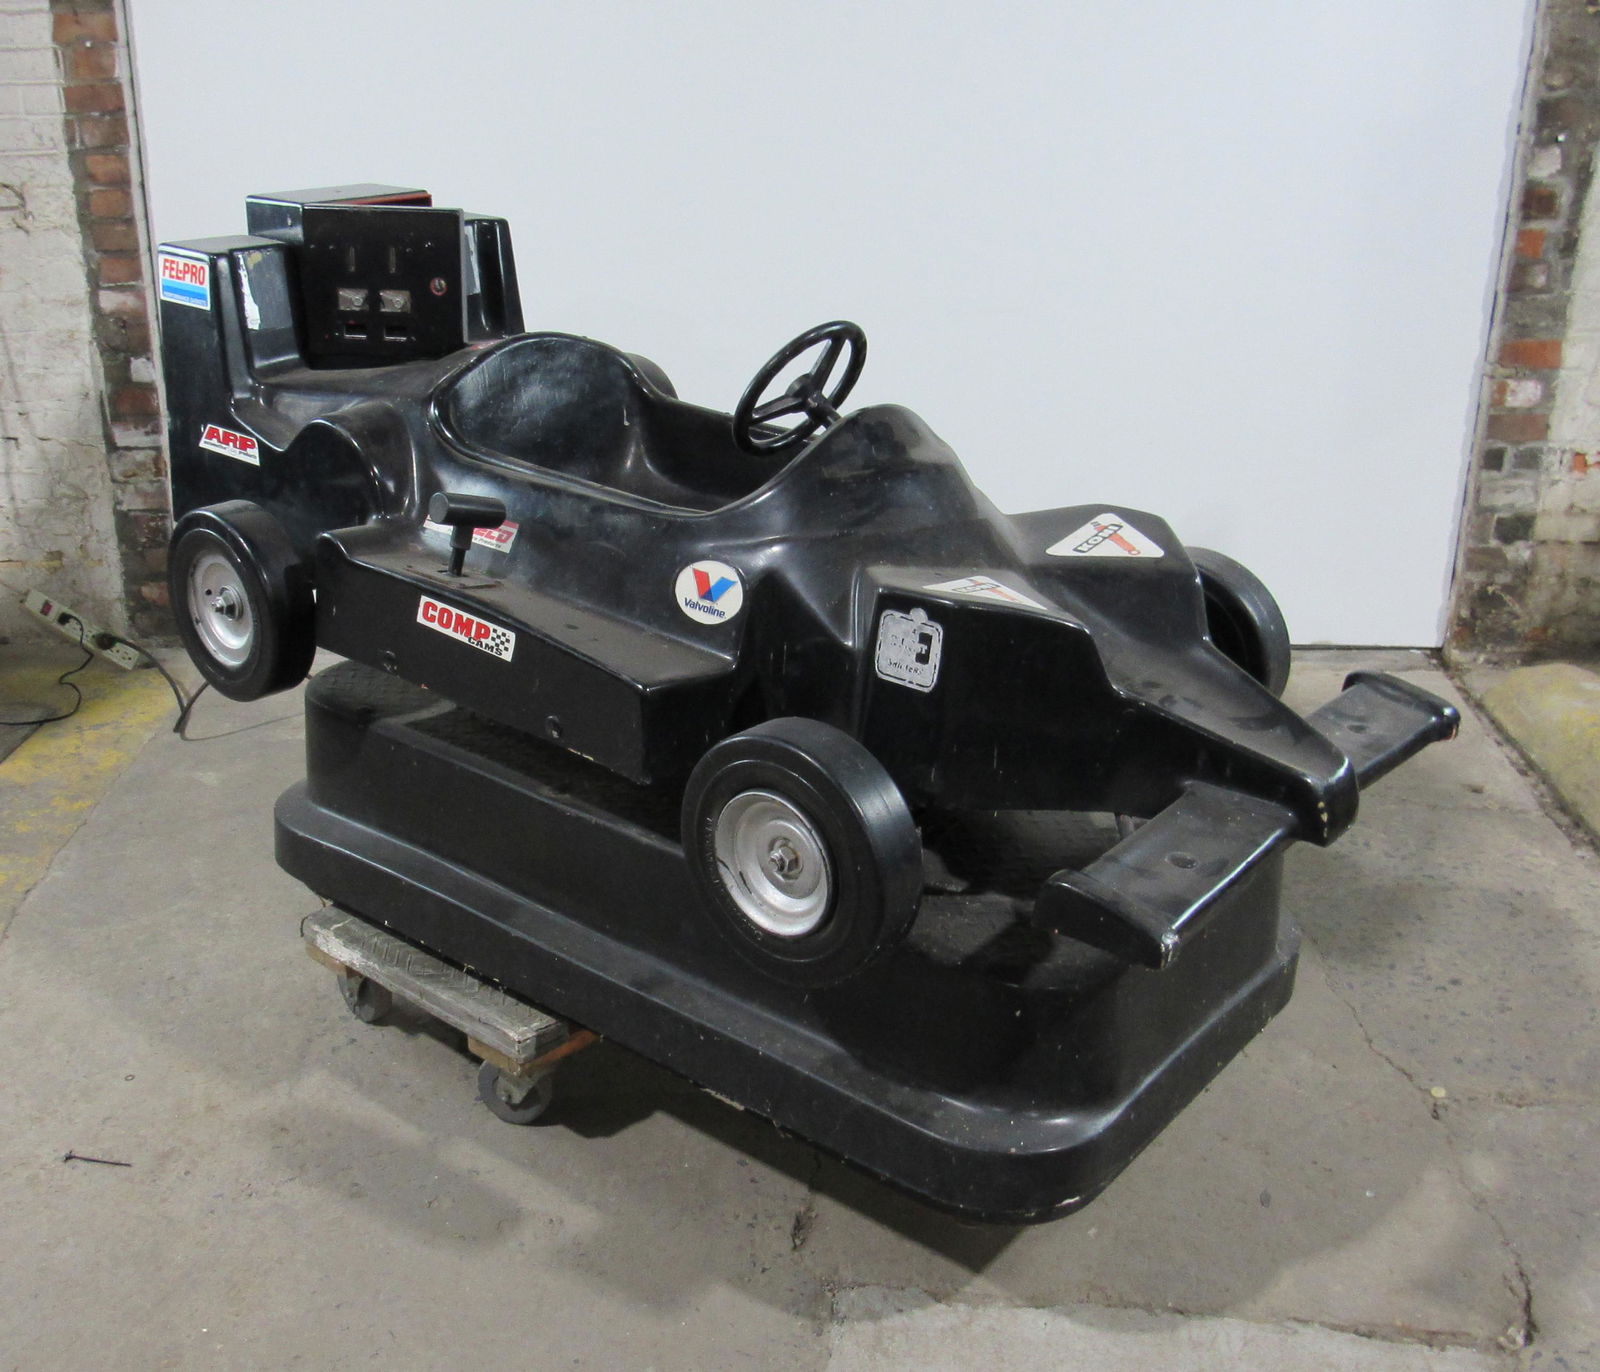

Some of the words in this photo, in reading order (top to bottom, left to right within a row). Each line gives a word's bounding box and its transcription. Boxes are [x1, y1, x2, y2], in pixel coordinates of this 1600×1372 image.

[162, 258, 206, 286] FEL-PRO
[204, 426, 257, 452] ARP
[422, 601, 491, 641] COMP
[684, 597, 726, 619] Valvoline
[467, 636, 503, 657] CAMS
